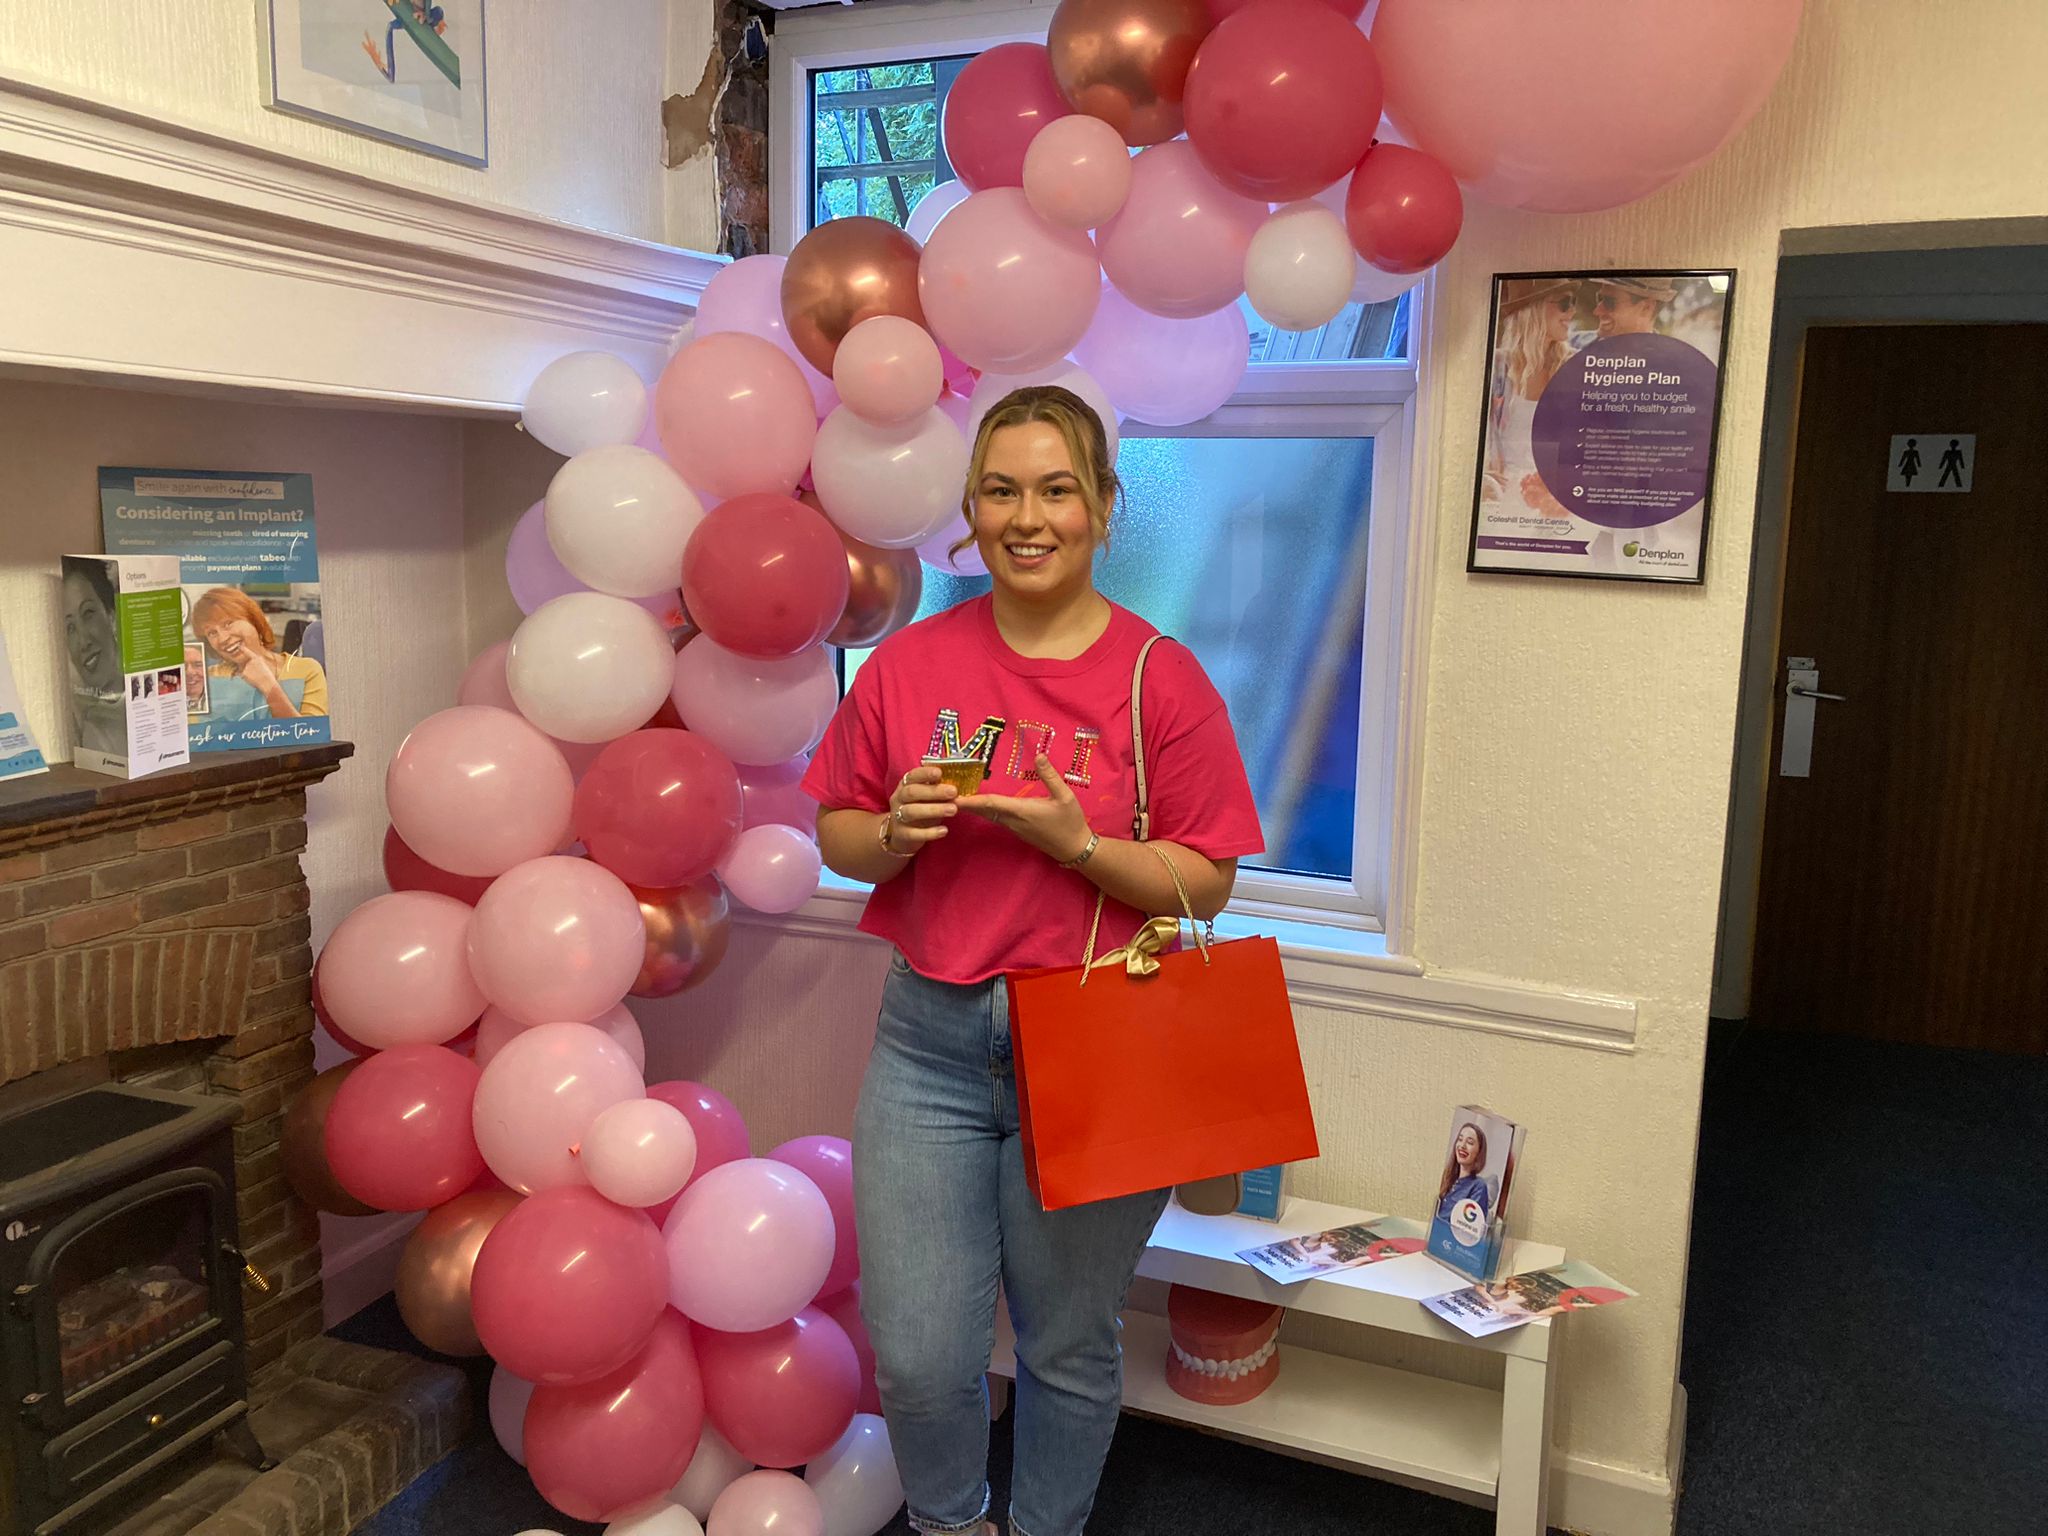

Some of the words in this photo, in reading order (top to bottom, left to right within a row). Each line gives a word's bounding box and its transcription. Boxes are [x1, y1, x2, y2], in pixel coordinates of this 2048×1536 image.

[1585, 355, 1646, 370] Denplan
[1584, 371, 1643, 386] Hygiene
[1647, 372, 1681, 385] Plan
[1582, 391, 1618, 402] Helping
[1620, 394, 1637, 402] you
[1641, 392, 1650, 401] to
[1653, 392, 1688, 403] budget
[1581, 403, 1592, 412] for
[1605, 403, 1631, 413] fresh,
[1633, 403, 1668, 415] healthy
[1670, 405, 1696, 414] smile
[172, 483, 201, 495] again
[115, 506, 214, 524] Considering
[216, 509, 235, 521] an
[239, 508, 304, 524] Implant?
[1488, 515, 1518, 523] Coleshill
[1519, 517, 1543, 525] Dental
[279, 530, 309, 539] wearing
[181, 554, 206, 562] ailable
[260, 553, 286, 562] tabeo
[1639, 548, 1684, 560] Denplan
[207, 564, 240, 573] payment
[241, 563, 262, 573] plans
[218, 732, 236, 743] our
[241, 724, 290, 744] reception
[290, 722, 321, 740] team
[1463, 1202, 1478, 1223] G
